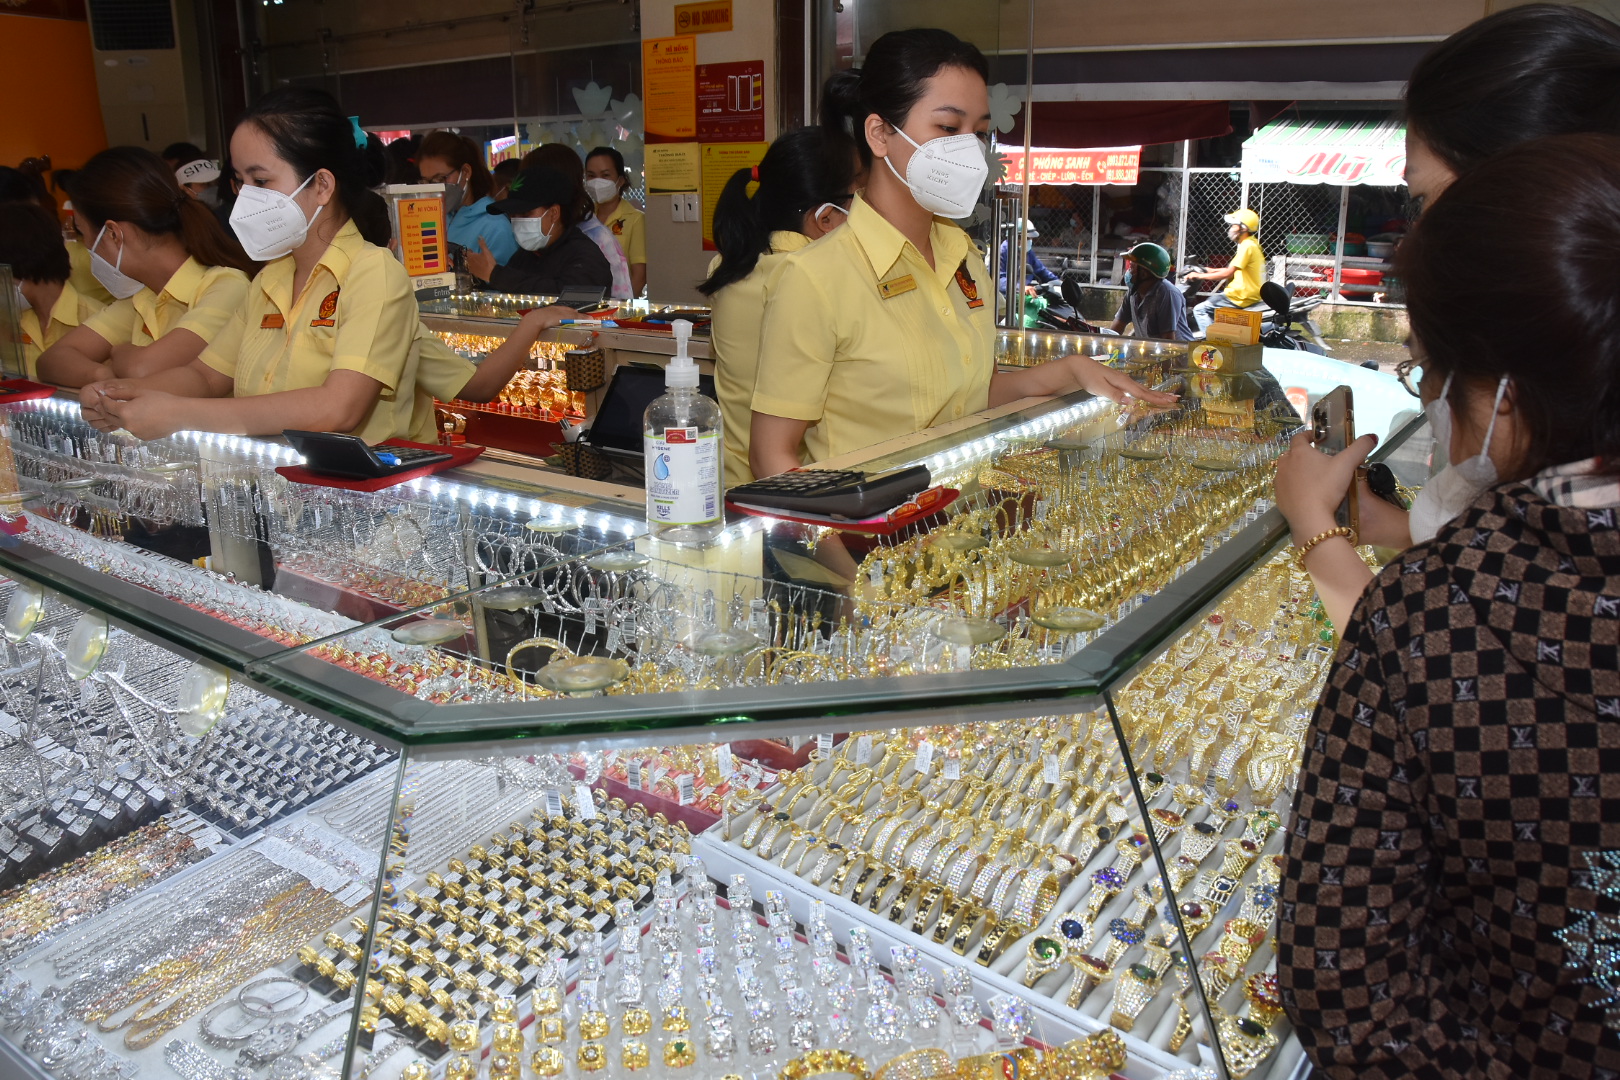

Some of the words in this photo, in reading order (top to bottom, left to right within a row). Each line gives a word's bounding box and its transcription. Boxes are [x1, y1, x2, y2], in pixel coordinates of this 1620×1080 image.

[692, 11, 700, 26] NO
[702, 8, 729, 25] SMOKING
[1064, 156, 1092, 170] SANH
